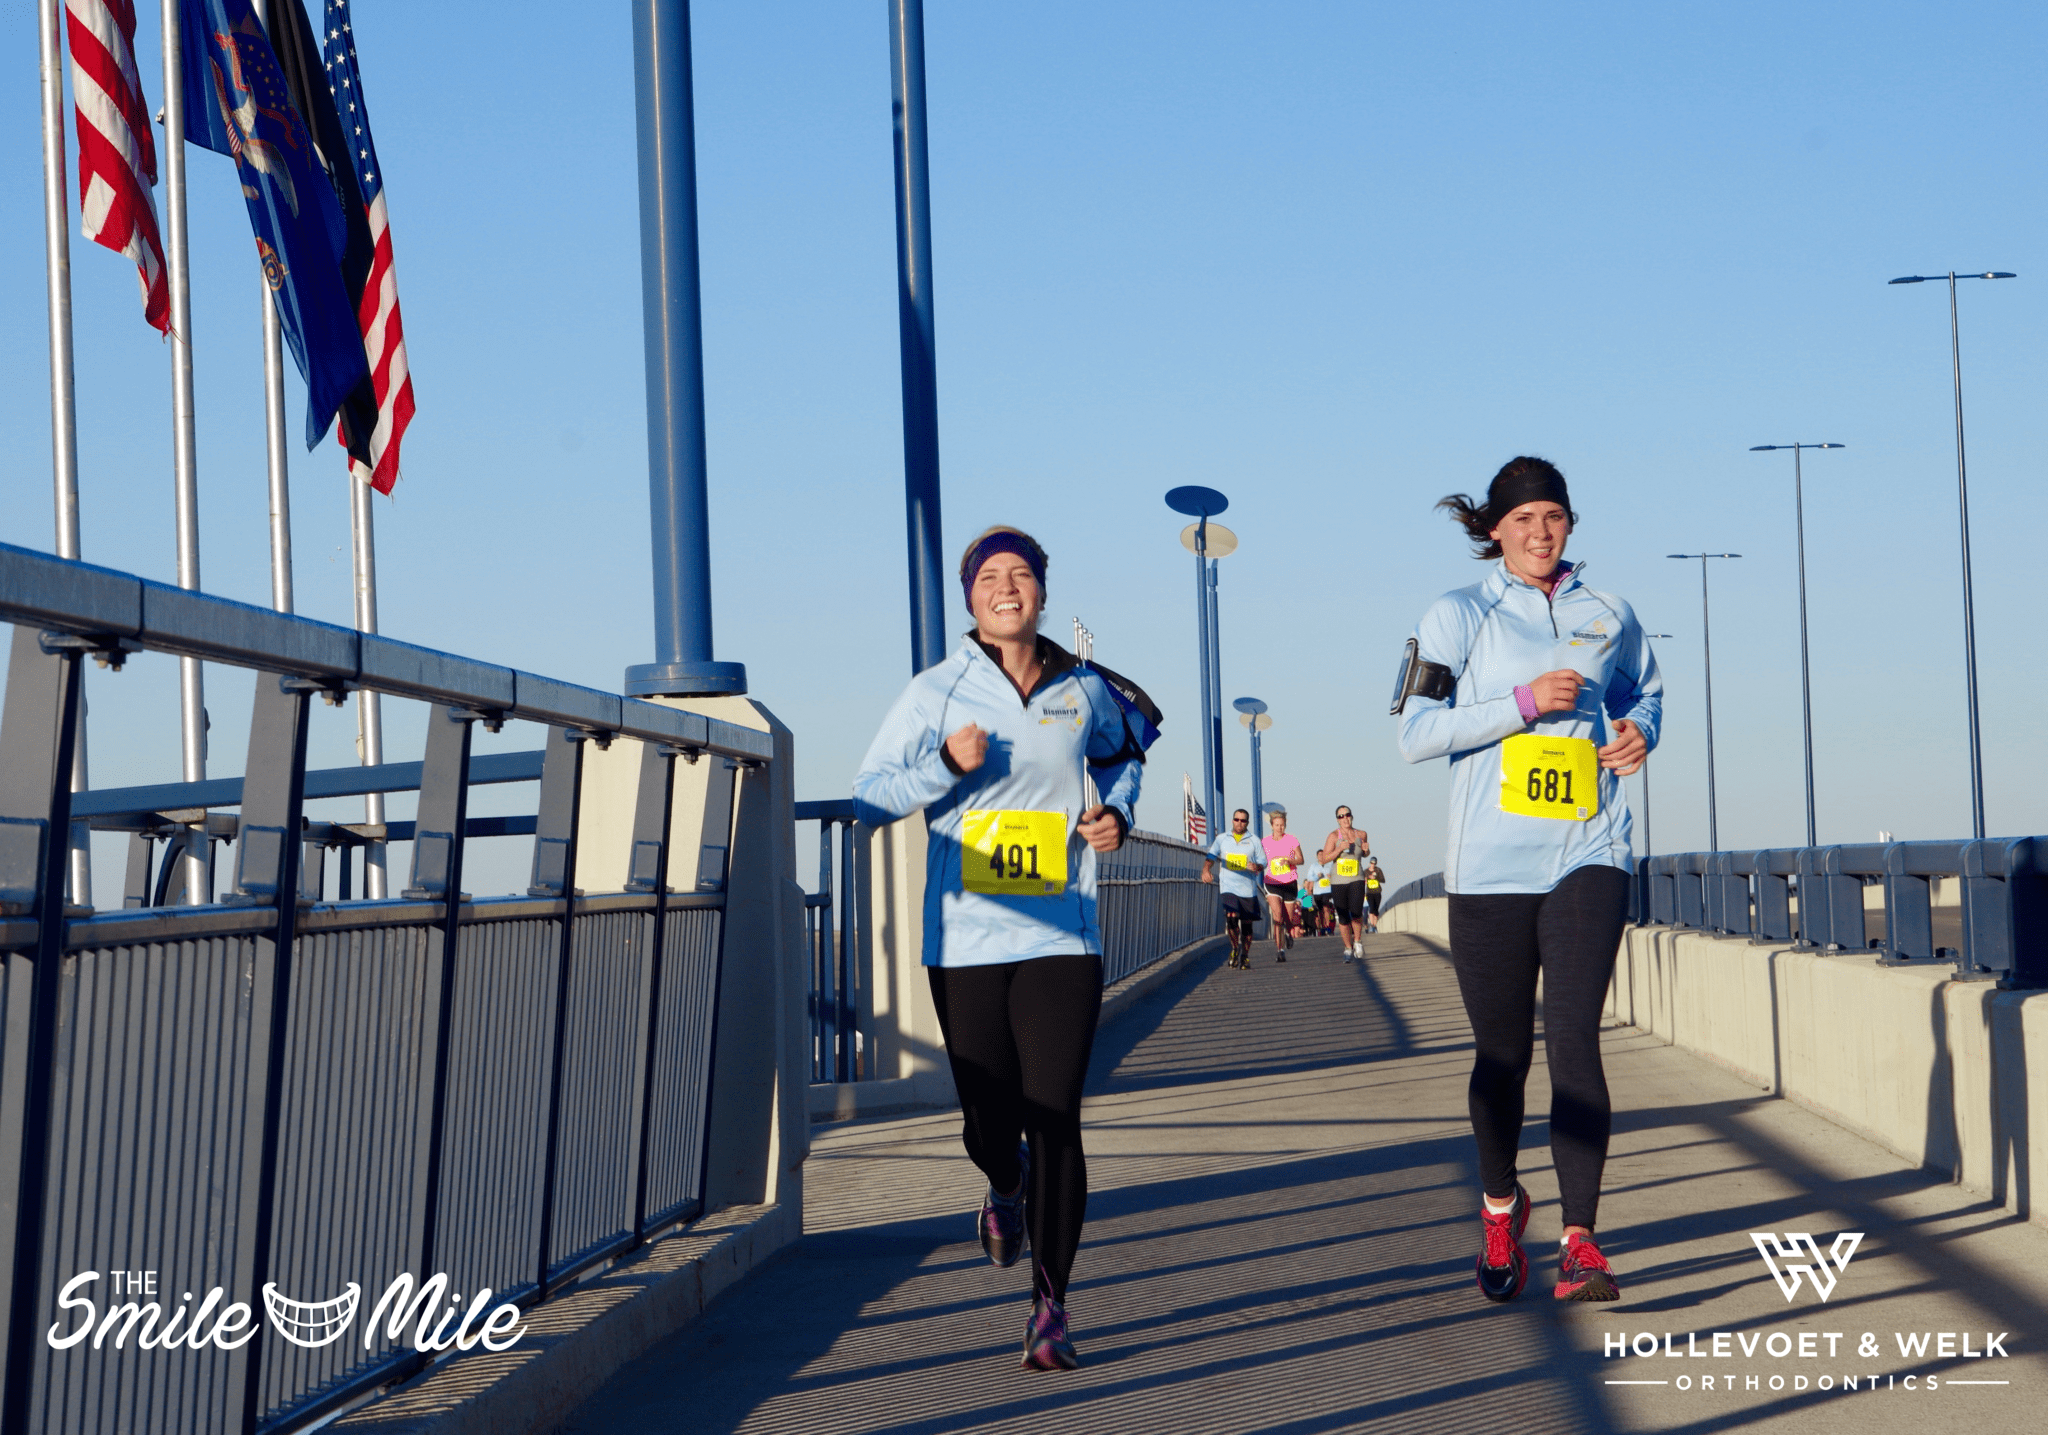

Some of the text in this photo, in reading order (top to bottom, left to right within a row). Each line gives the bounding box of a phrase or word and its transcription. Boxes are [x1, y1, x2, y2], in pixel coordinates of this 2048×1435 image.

[1042, 707, 1078, 716] Bismarck
[1527, 767, 1574, 805] 681
[990, 843, 1041, 879] 491
